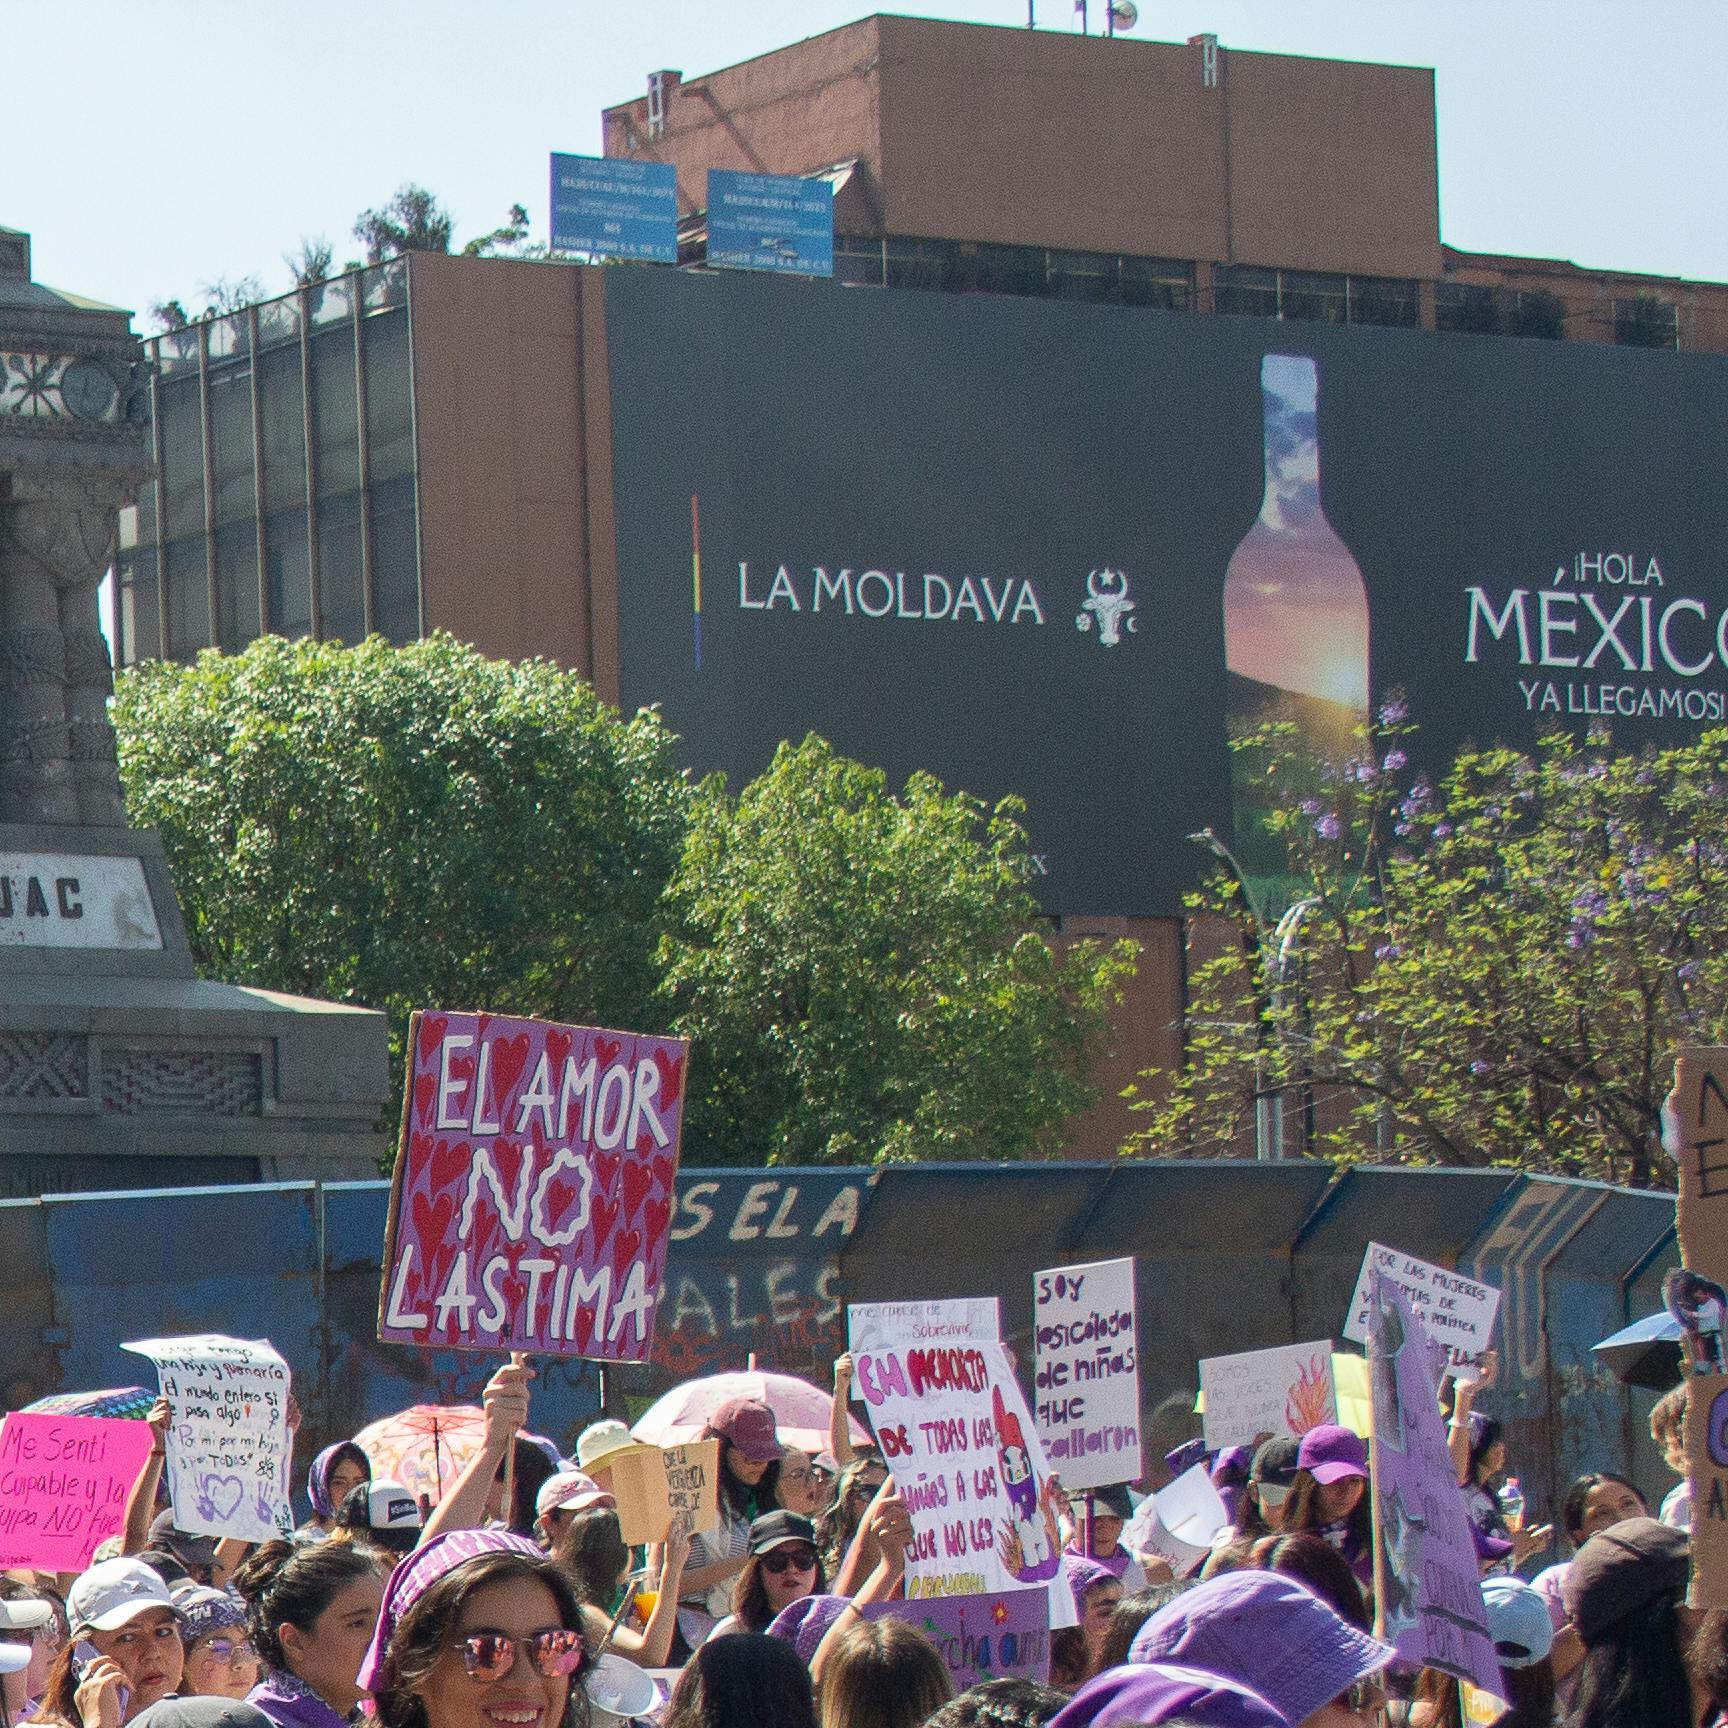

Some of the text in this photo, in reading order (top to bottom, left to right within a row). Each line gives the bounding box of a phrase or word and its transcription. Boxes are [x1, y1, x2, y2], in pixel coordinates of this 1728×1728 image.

[737, 562, 1045, 628] LA MOLDAVA
[1518, 680, 1725, 720] YA LLEGAMOS!
[436, 1034, 670, 1151] EL AMOR
[458, 1143, 594, 1248] NO
[384, 1243, 654, 1344] LASTIMA
[1036, 1309, 1134, 1356] psicóloga
[1036, 1346, 1136, 1390] de niñas
[224, 1387, 263, 1404] entero
[1037, 1396, 1085, 1427] que
[216, 1405, 242, 1427] algo
[2, 1425, 38, 1464] Me
[877, 1424, 915, 1459] DE
[920, 1419, 968, 1455] TODAS
[1039, 1423, 1138, 1460] callaron
[85, 1479, 98, 1513] y
[105, 1476, 126, 1504] la
[955, 1470, 967, 1495] A
[974, 1464, 998, 1499] LAS
[42, 1504, 83, 1532] NO
[970, 1518, 995, 1550] LES
